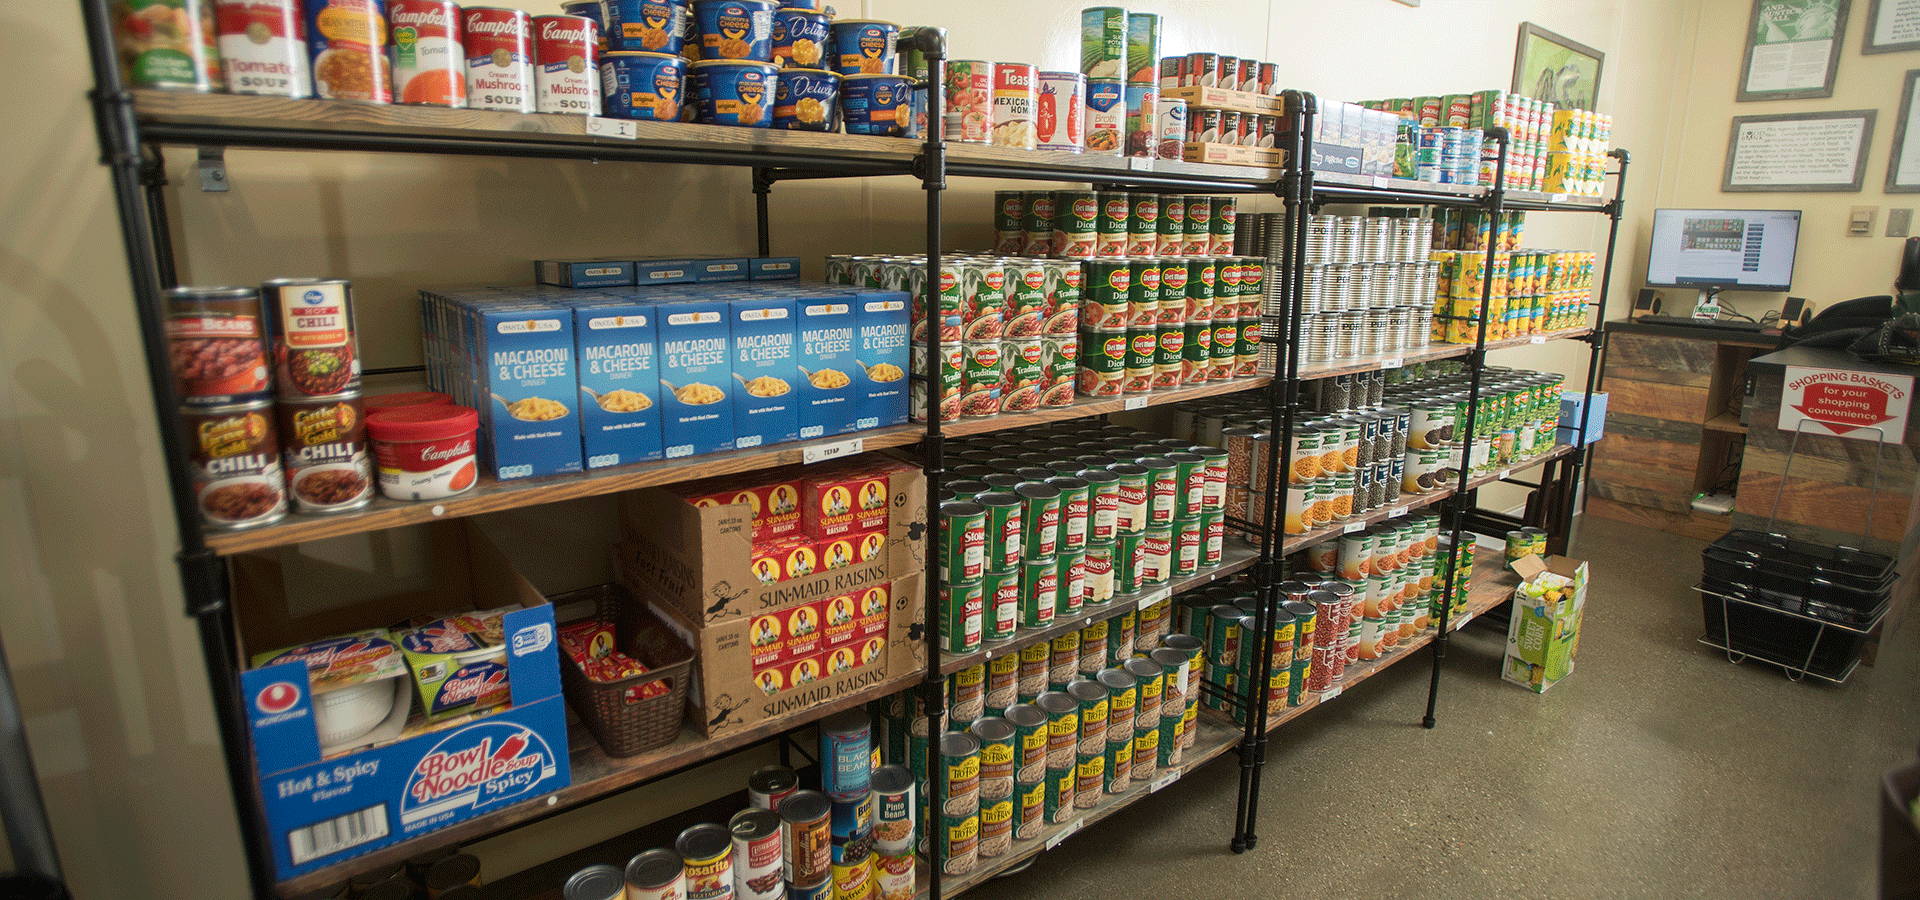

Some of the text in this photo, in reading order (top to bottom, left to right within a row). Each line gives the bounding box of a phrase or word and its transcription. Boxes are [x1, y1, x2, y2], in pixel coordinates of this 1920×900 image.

[788, 16, 829, 38] Deluxe
[421, 46, 450, 57] Tomat
[240, 77, 289, 89] SOUP
[1002, 69, 1029, 86] Teas
[551, 84, 598, 97] Mushrom
[791, 76, 833, 97] Deluxe
[560, 99, 588, 109] SOU
[1095, 114, 1117, 123] Broth
[1076, 220, 1096, 229] Diced
[1109, 221, 1127, 229] Diced
[1165, 288, 1186, 296] Diced
[1240, 284, 1260, 292] Diced
[297, 317, 336, 329] CHILI
[803, 328, 853, 343] MACARONI
[861, 324, 907, 338] MACARONI
[665, 338, 726, 354] MACARONI
[736, 333, 793, 349] MACARONI
[805, 340, 851, 355] & CHEESE
[863, 335, 905, 350] & CHEESE
[494, 348, 568, 366] MACARONI
[585, 342, 653, 360] MACARONI
[739, 345, 790, 362] & CHEESE
[1163, 352, 1182, 360] Diced
[1217, 346, 1235, 354] Diced
[590, 356, 650, 374] & CHEESE
[668, 351, 724, 368] & CHEESE
[499, 362, 566, 380] & CHEESE
[521, 378, 546, 387] DINNER
[1789, 372, 1905, 400] SHOPPING BASKETS
[1824, 386, 1868, 398] for your
[1818, 397, 1870, 410] shopping
[1808, 407, 1878, 420] convenience
[300, 442, 354, 461] CHILI
[824, 447, 840, 456] TEFAP
[206, 454, 266, 474] CHILI
[719, 526, 742, 534] CARTONS
[773, 523, 795, 534] RAISINS
[826, 525, 849, 536] RAISINS
[862, 519, 883, 528] RAISINS
[835, 564, 885, 591] RAISINS
[514, 635, 523, 648] 3
[830, 634, 852, 645] RAISINS
[1524, 619, 1537, 650] SWEET
[1532, 625, 1544, 650] CORN
[793, 644, 815, 655] RAISINS
[444, 672, 484, 692] Bowl
[836, 667, 885, 695] RAISINS
[418, 739, 489, 778] Bowl
[277, 759, 380, 799] Hot & Spicy
[412, 754, 539, 801] Noodle Soup
[486, 769, 534, 793] Spicy
[312, 784, 353, 803] Flavor
[884, 809, 906, 819] Beans
[886, 802, 905, 811] Pinto
[404, 819, 428, 832] MADE
[438, 811, 455, 822] USA
